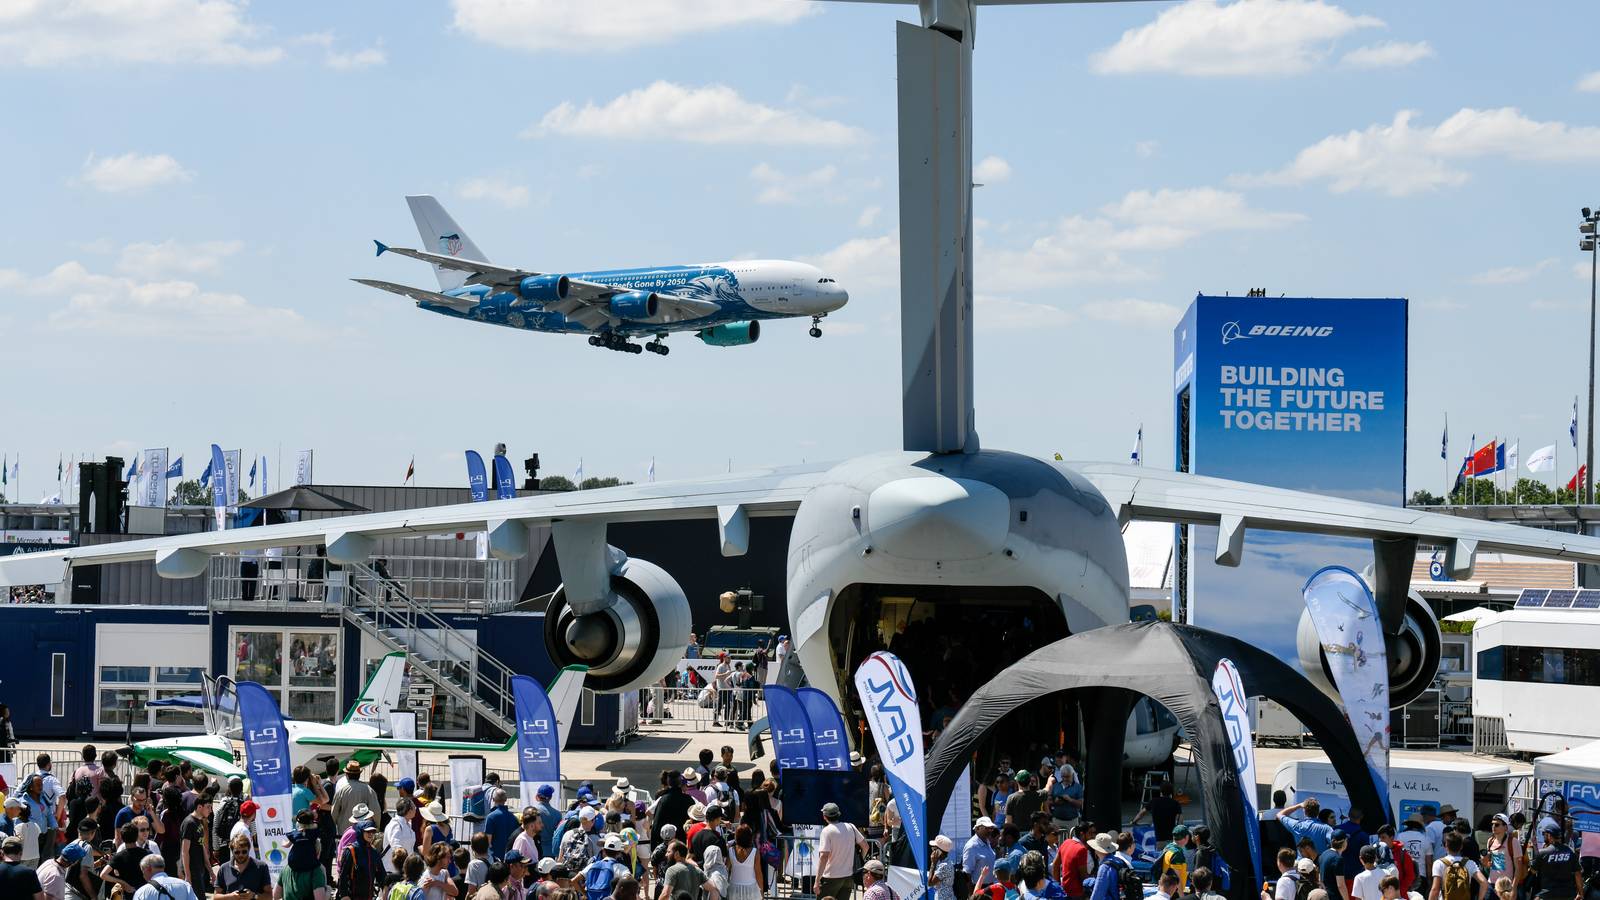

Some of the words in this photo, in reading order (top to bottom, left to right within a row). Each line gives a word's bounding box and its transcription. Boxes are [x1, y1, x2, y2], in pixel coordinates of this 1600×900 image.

[656, 280, 666, 288] By
[1248, 324, 1334, 337] BOEING
[1221, 366, 1345, 387] BUILDING
[1220, 388, 1271, 408] THE
[1281, 390, 1384, 410] FUTURE
[1220, 410, 1361, 432] TOGETHER
[1392, 781, 1400, 790] de
[1404, 782, 1417, 790] Vol
[1421, 783, 1440, 792] Libre
[1548, 853, 1570, 862] F135
